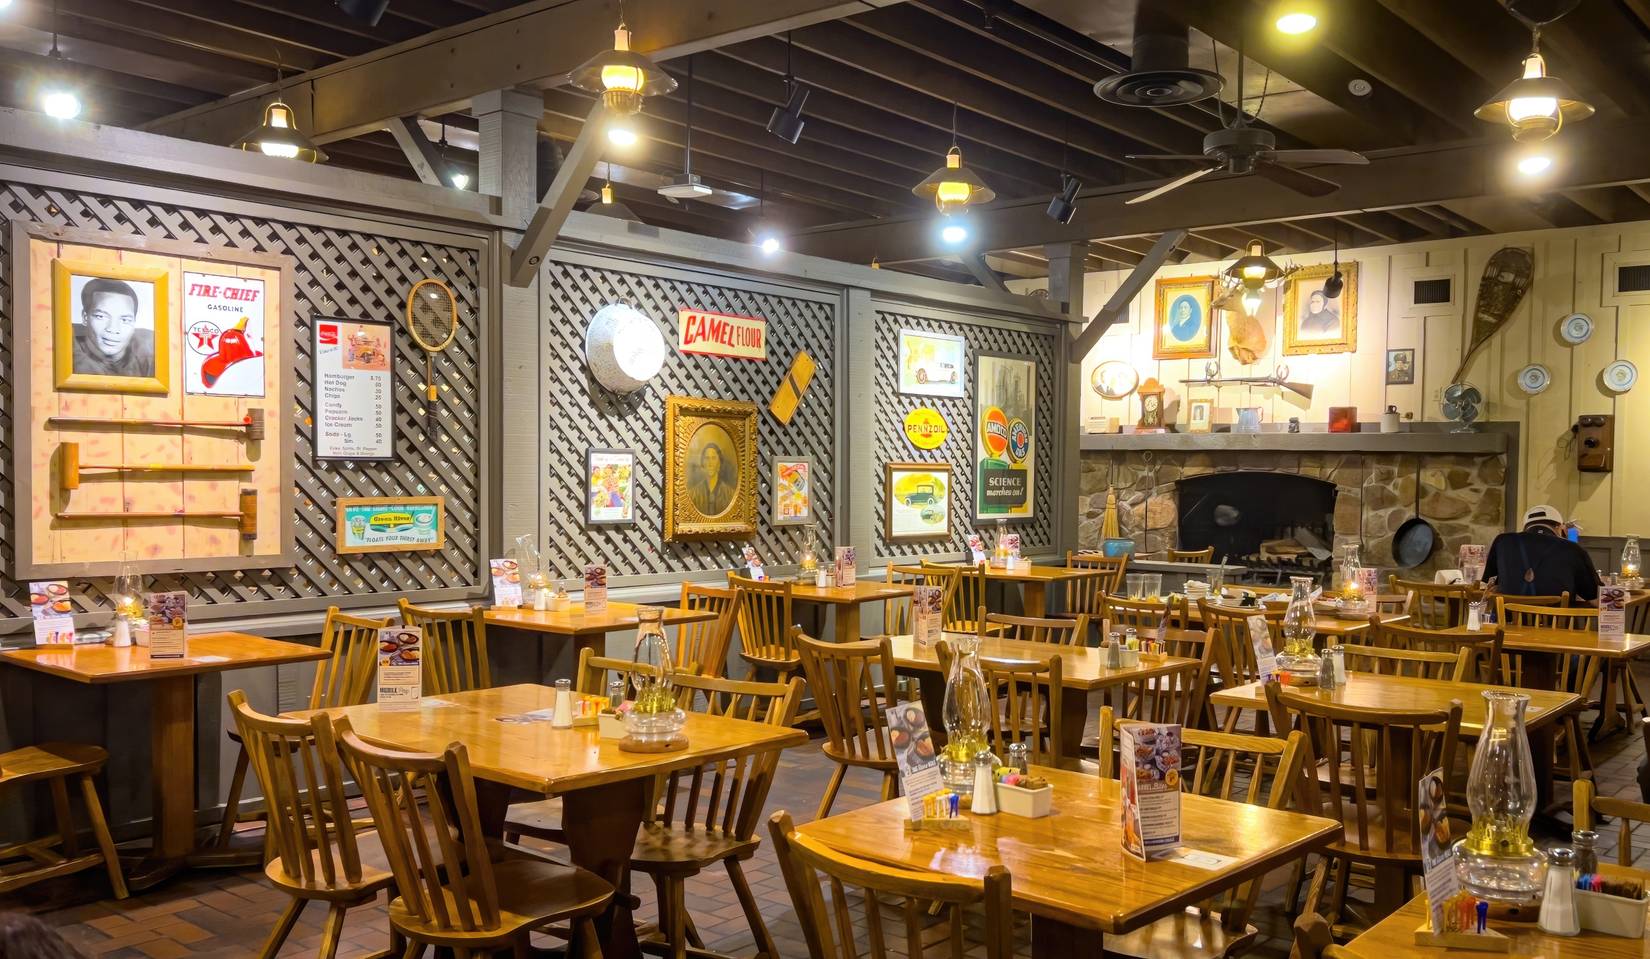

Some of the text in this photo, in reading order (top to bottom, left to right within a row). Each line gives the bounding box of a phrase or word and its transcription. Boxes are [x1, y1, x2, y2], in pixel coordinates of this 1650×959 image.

[188, 283, 260, 302] FIRE-CHIEF
[207, 304, 244, 313] GASOLINE
[683, 315, 762, 349] CAMEL FLOUR
[324, 373, 355, 381] Hamburger
[907, 424, 946, 433] PENNZOIL
[988, 476, 1022, 487] SCIENCE
[986, 486, 1024, 497] marches on!
